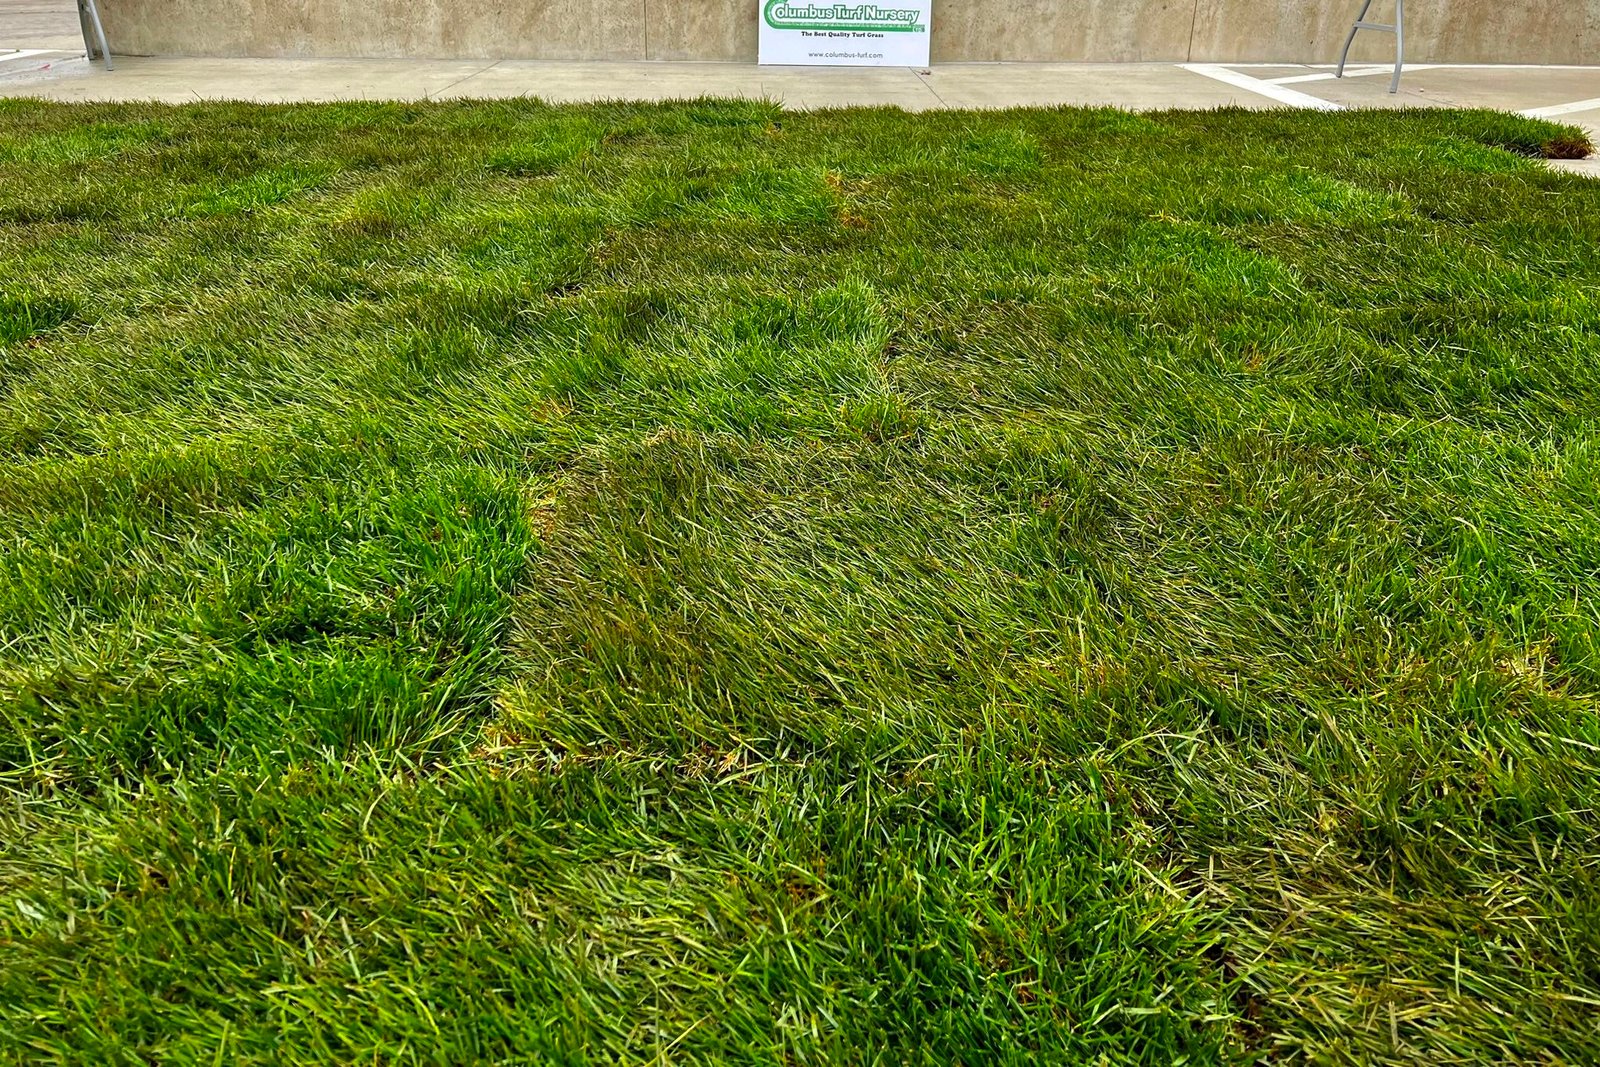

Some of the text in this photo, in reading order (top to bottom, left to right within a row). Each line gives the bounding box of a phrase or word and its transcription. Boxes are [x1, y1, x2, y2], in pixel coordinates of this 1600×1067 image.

[764, 0, 920, 29] Columbus Turf Nursery
